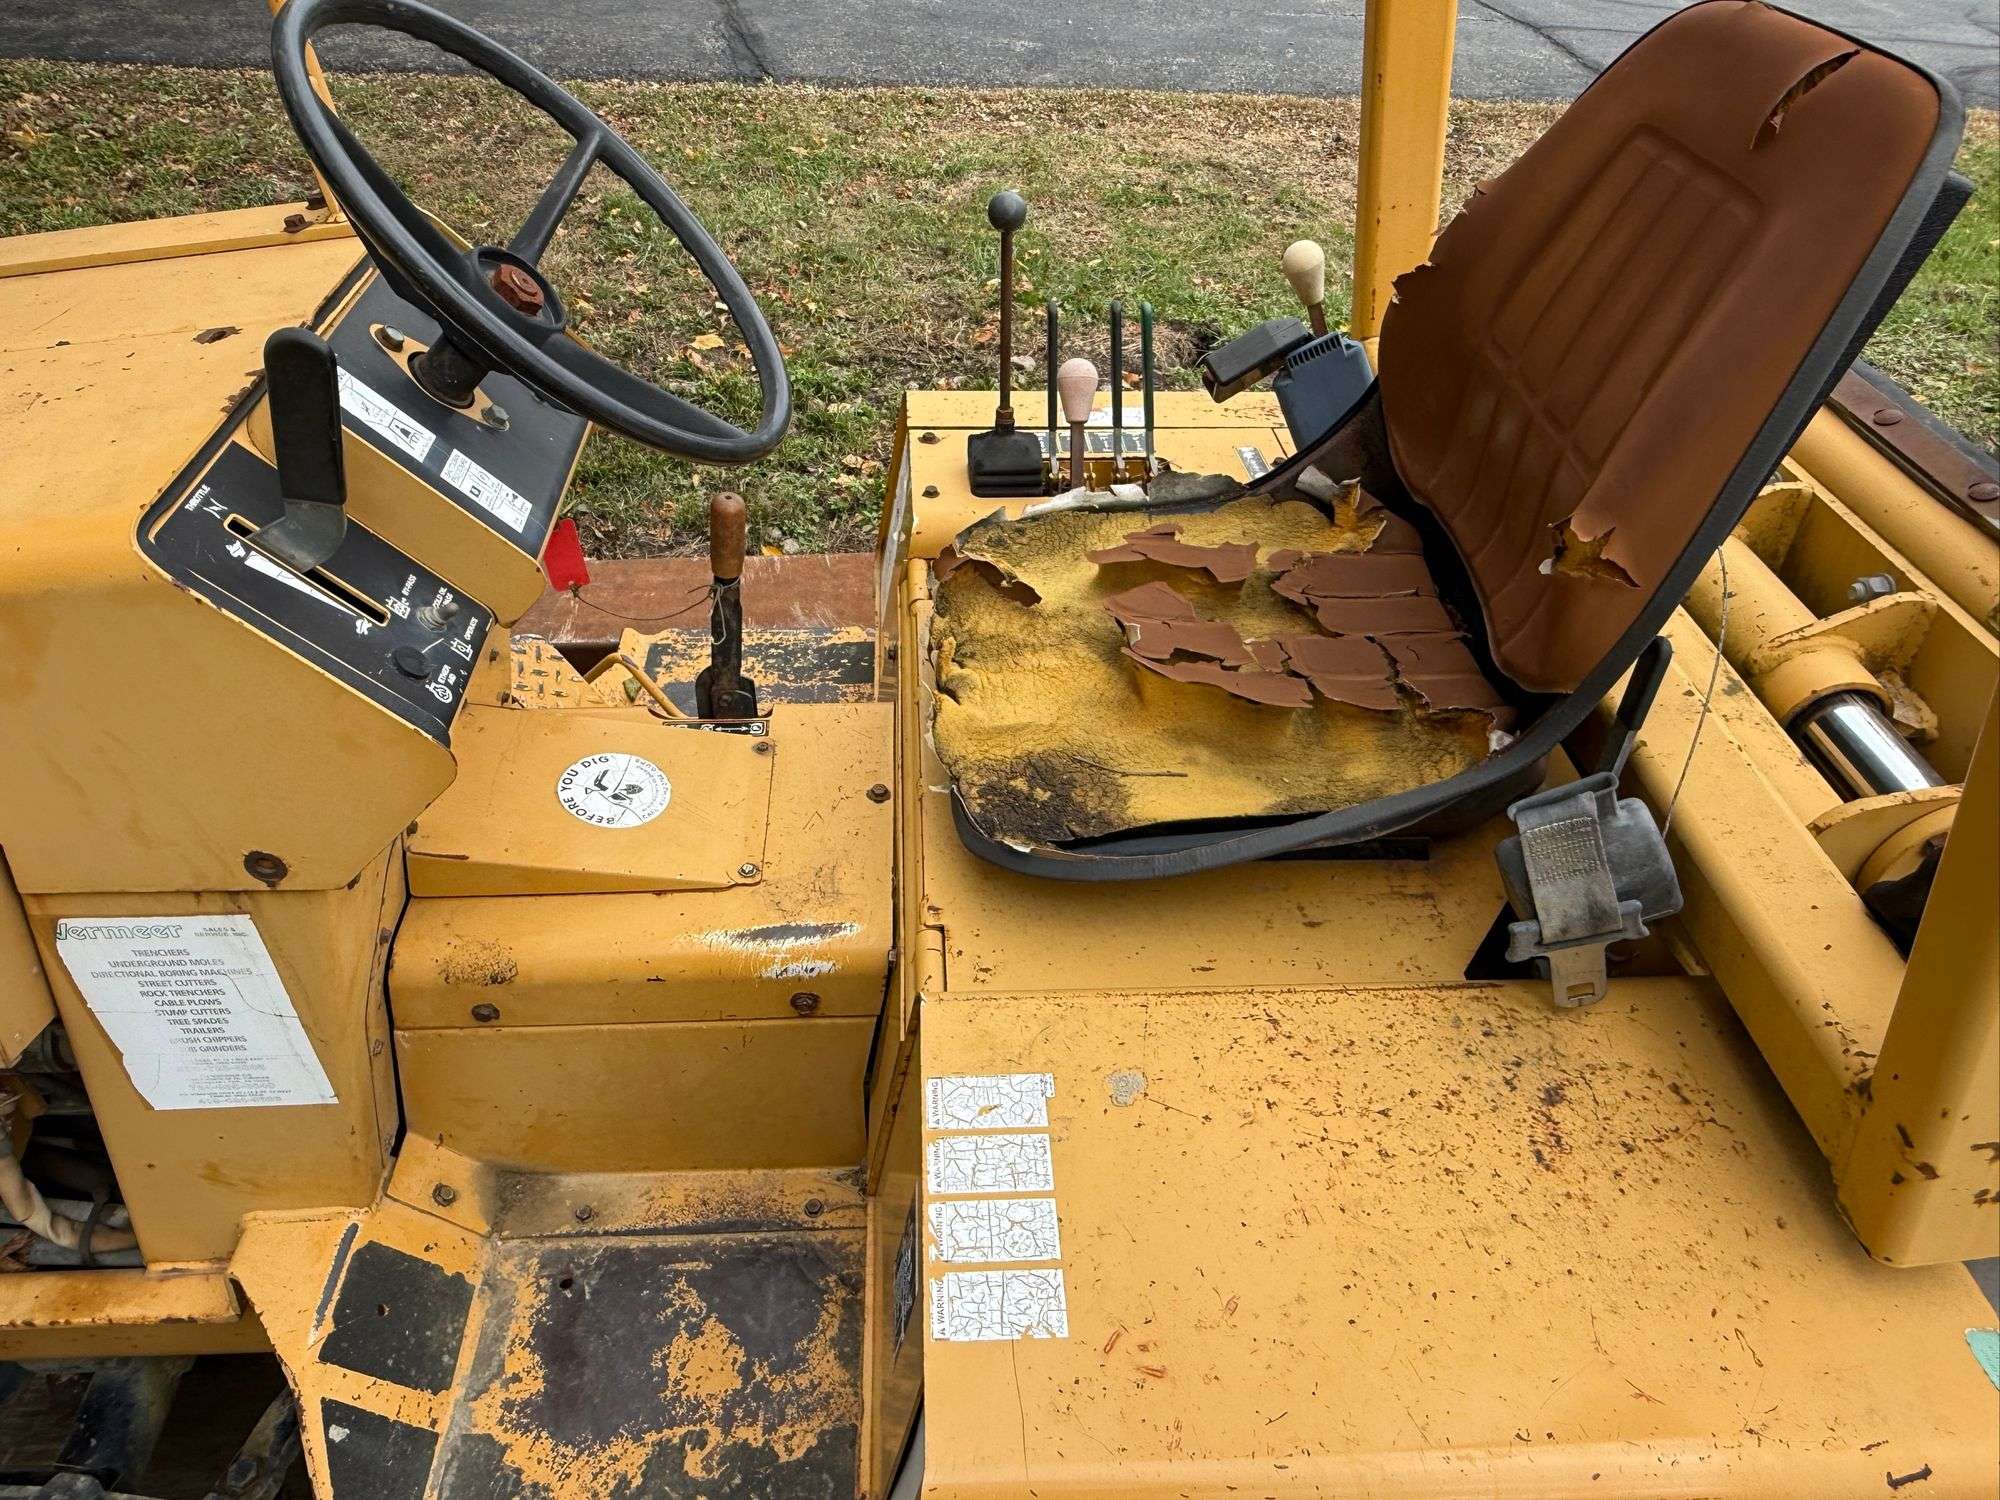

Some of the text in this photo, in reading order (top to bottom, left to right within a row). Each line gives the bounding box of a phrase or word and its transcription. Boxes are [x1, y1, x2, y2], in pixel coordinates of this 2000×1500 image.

[184, 485, 211, 511] THROTTLE
[560, 755, 615, 825] BEFORE YOU DIG
[131, 949, 190, 957] TRENCHERS
[108, 958, 225, 968] UNDERGROUND MOLES
[91, 968, 252, 979] DIRECTIONAL BORING MACHINES
[138, 978, 218, 988] STREET CUTTERS
[140, 988, 227, 998] ROCK TRENCHERS
[188, 998, 222, 1006] PLOWS
[155, 1007, 232, 1017] STUMP CUTTERS
[166, 1017, 230, 1026] TREE SPADES
[180, 1026, 225, 1035] TRAILERS
[170, 1035, 248, 1045] USH CHIPPERS
[199, 1044, 247, 1053] GRINDERS
[932, 1081, 940, 1117] WARNING
